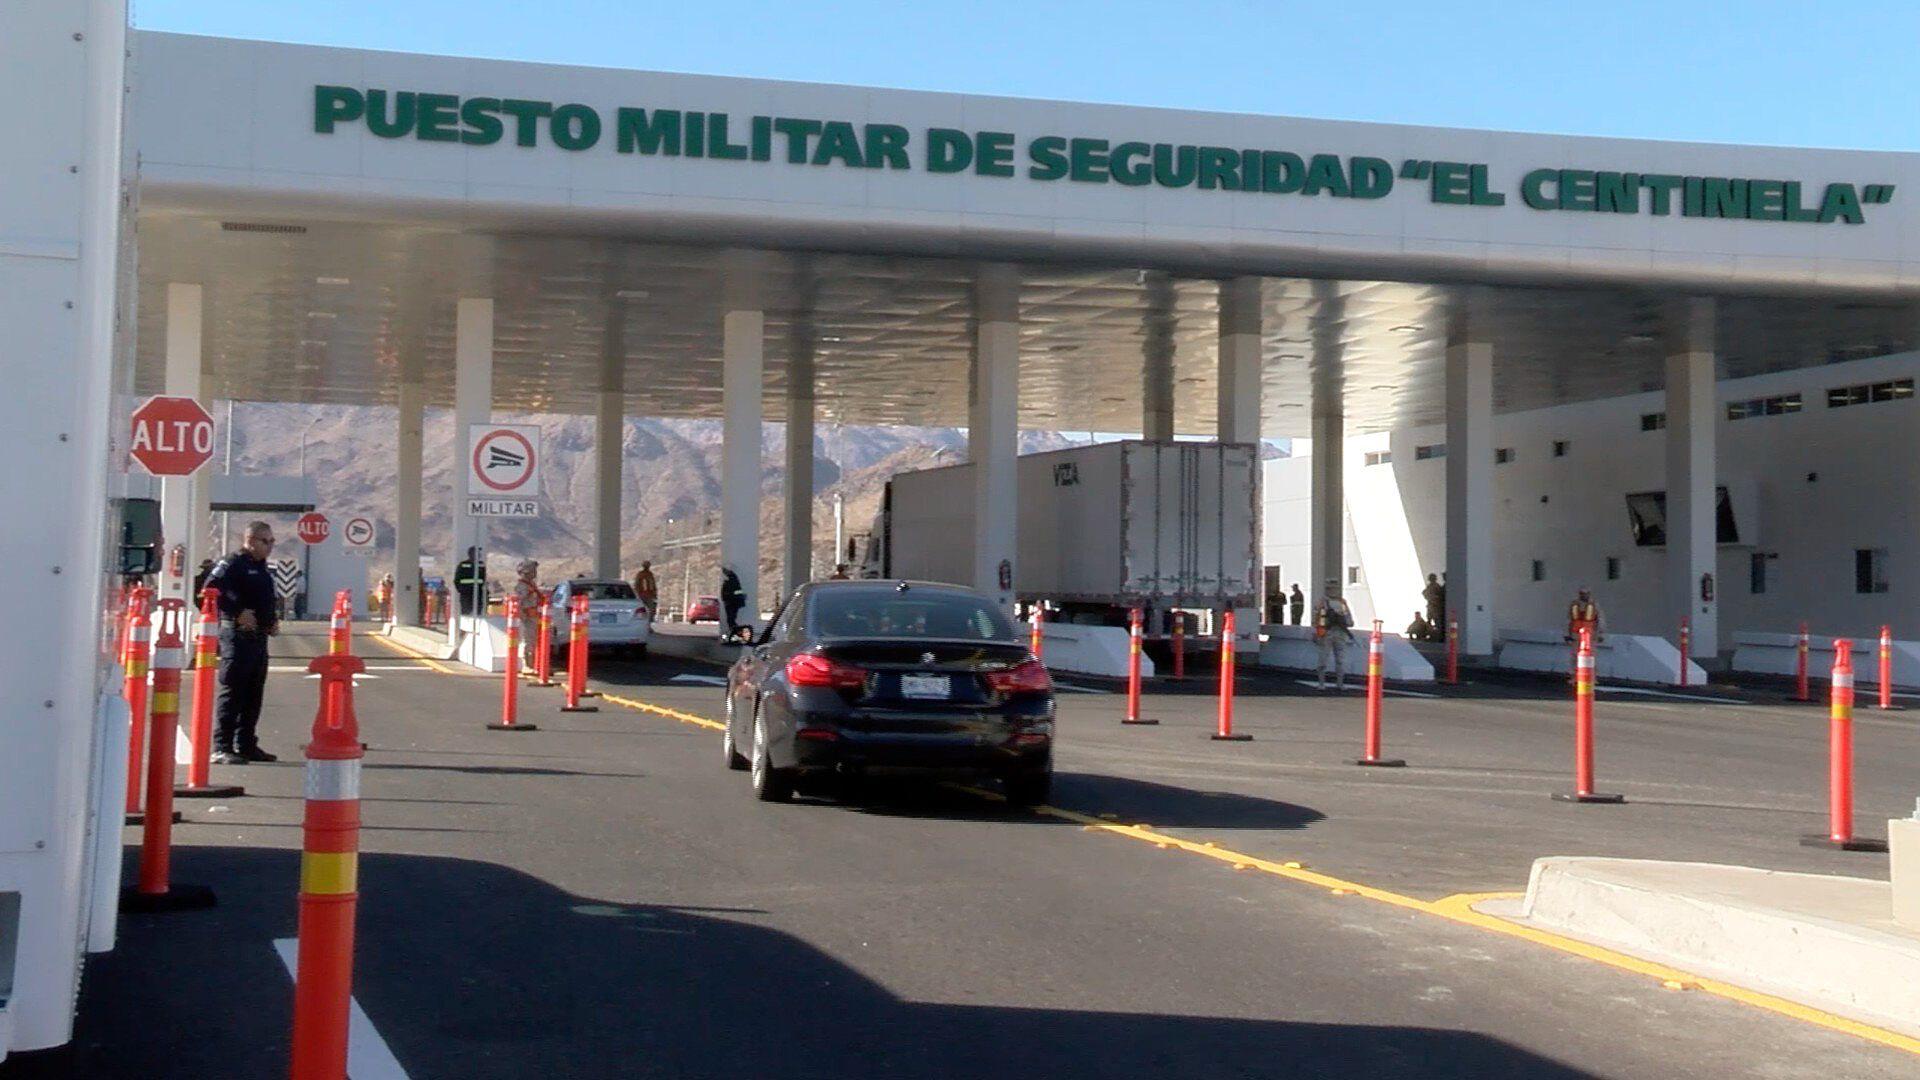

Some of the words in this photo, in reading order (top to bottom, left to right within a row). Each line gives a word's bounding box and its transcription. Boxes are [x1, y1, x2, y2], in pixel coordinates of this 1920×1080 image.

[314, 86, 601, 151] PUESTO
[617, 106, 910, 172] MILITAR
[928, 128, 1016, 177] DE
[1030, 137, 1394, 199] SEGURIDAD
[131, 419, 213, 453] ALTO
[470, 502, 536, 515] MILITAR
[298, 521, 329, 535] ALTO
